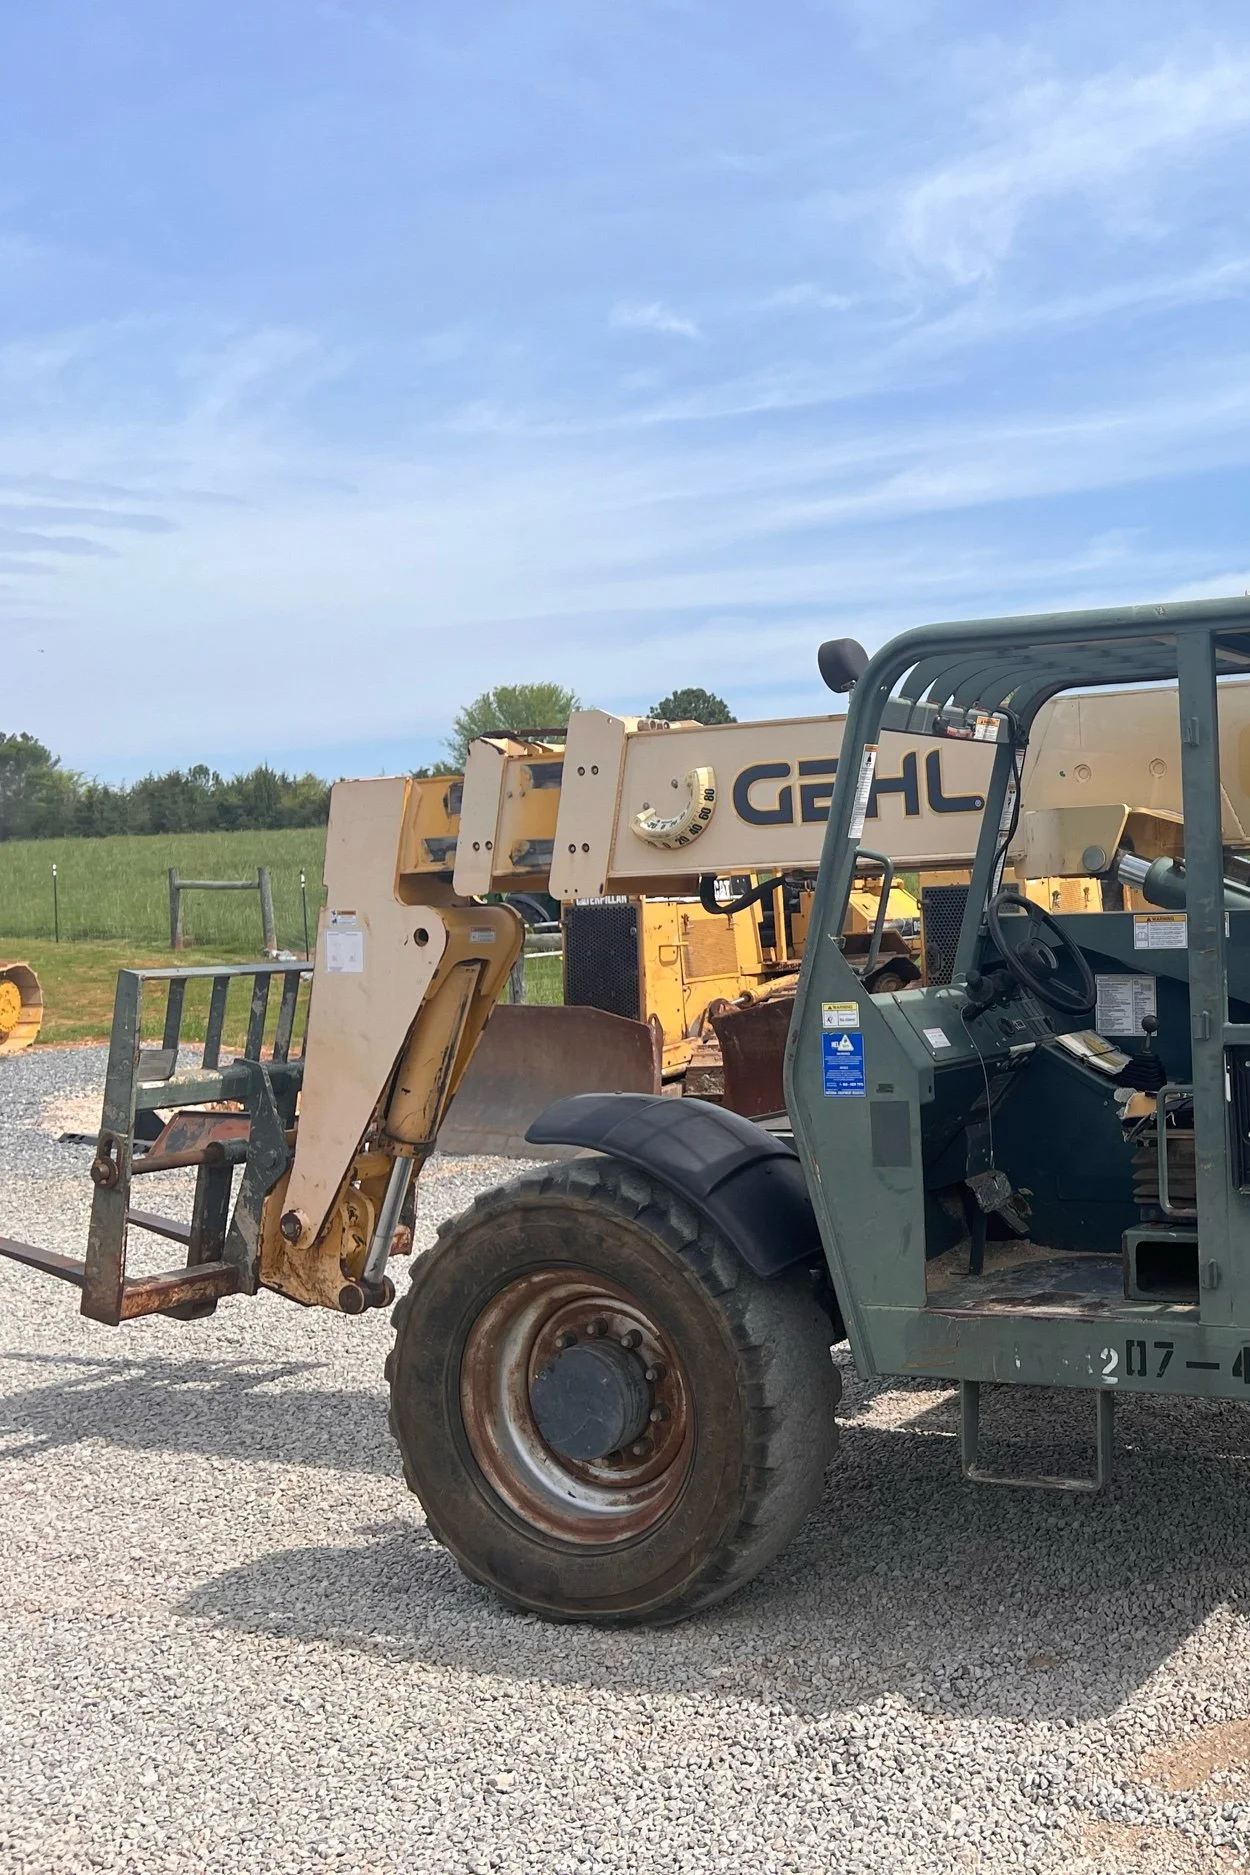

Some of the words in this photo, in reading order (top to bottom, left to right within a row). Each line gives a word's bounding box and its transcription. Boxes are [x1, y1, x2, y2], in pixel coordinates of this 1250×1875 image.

[703, 788, 715, 802] 80
[731, 747, 986, 829] GEHL
[698, 806, 712, 820] 60
[688, 823, 703, 836] 40
[675, 835, 690, 845] 20
[713, 879, 731, 901] CAT
